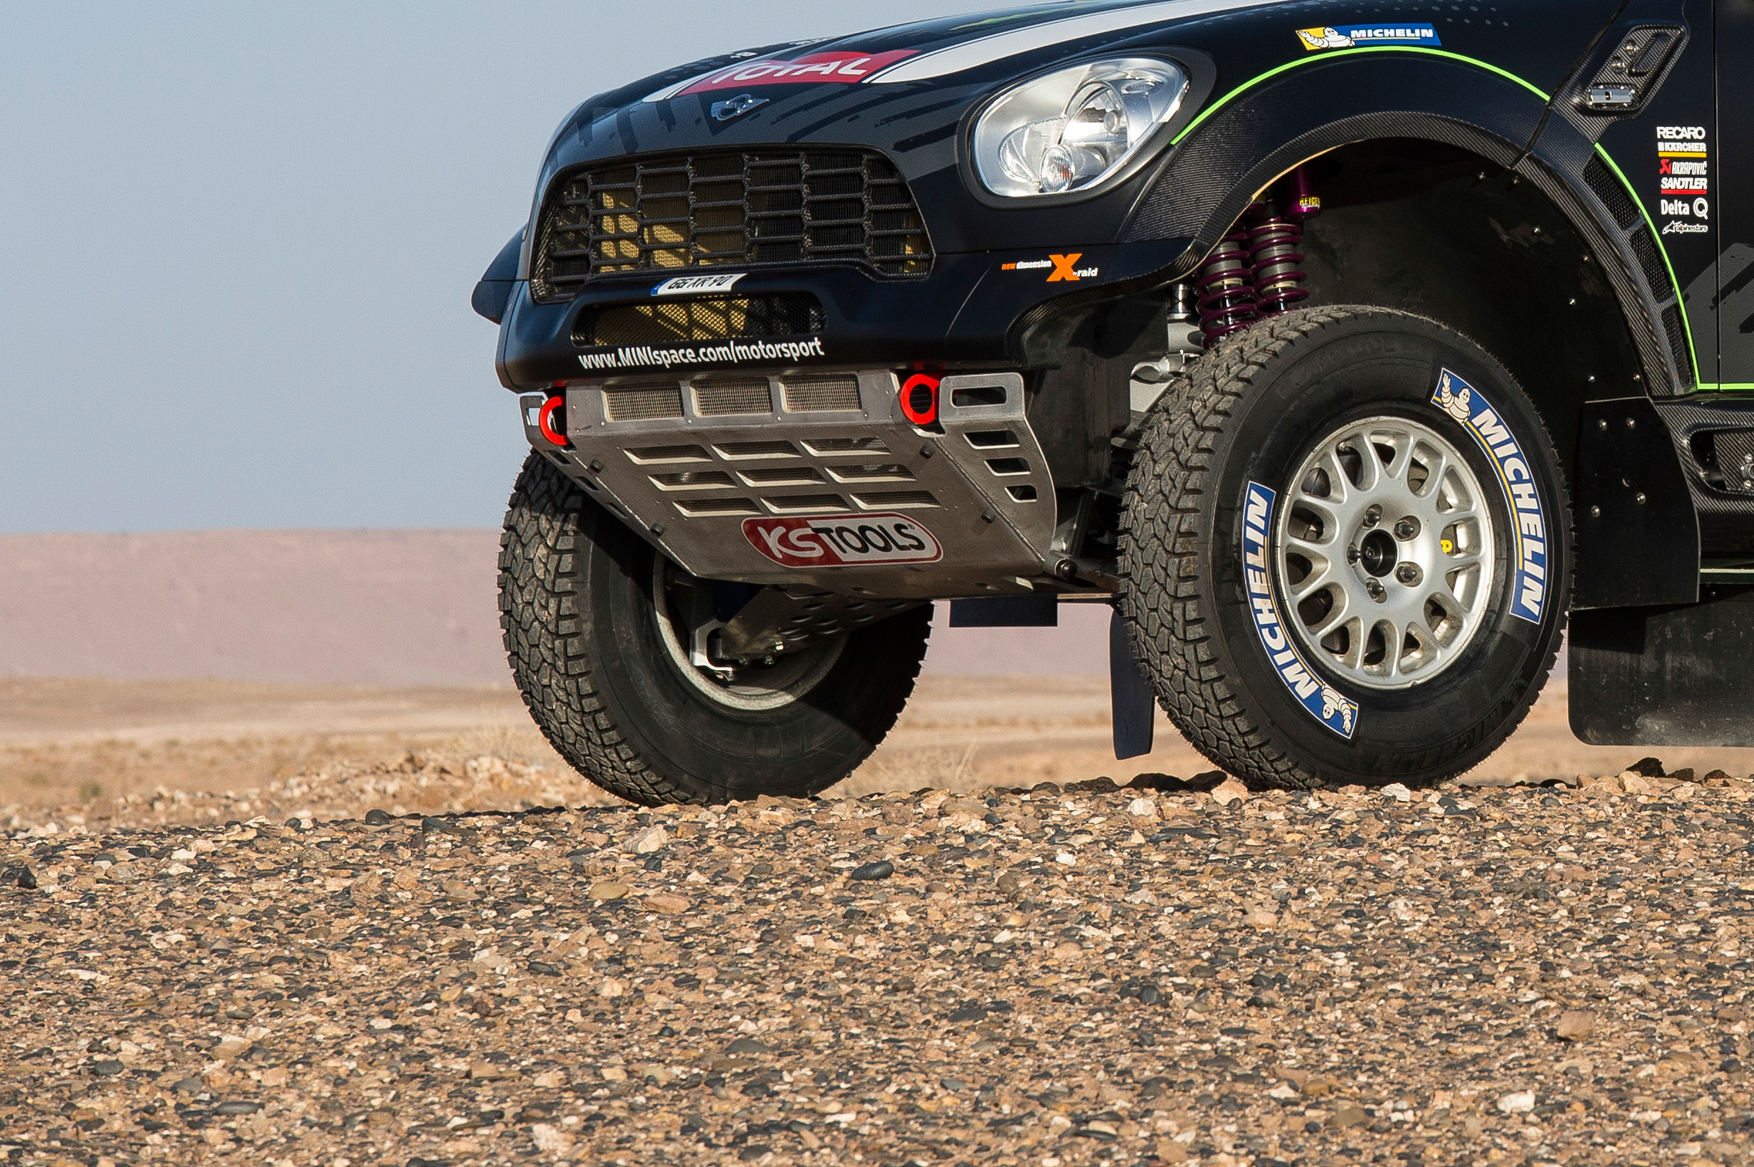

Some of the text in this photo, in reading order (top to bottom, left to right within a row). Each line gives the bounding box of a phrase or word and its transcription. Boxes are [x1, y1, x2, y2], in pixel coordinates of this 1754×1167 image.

[1350, 28, 1434, 38] MICHELIN
[711, 57, 872, 84] TOTAL
[1656, 126, 1706, 140] RECARO
[1660, 177, 1708, 190] SANDTLER
[1660, 197, 1709, 220] Delta Q
[1001, 262, 1016, 271] new
[1016, 259, 1053, 270] dimension
[577, 336, 826, 370] www.MINIspace.com/motorsport
[1472, 407, 1544, 616] MICHELIN
[1245, 486, 1319, 700] MICHELIN
